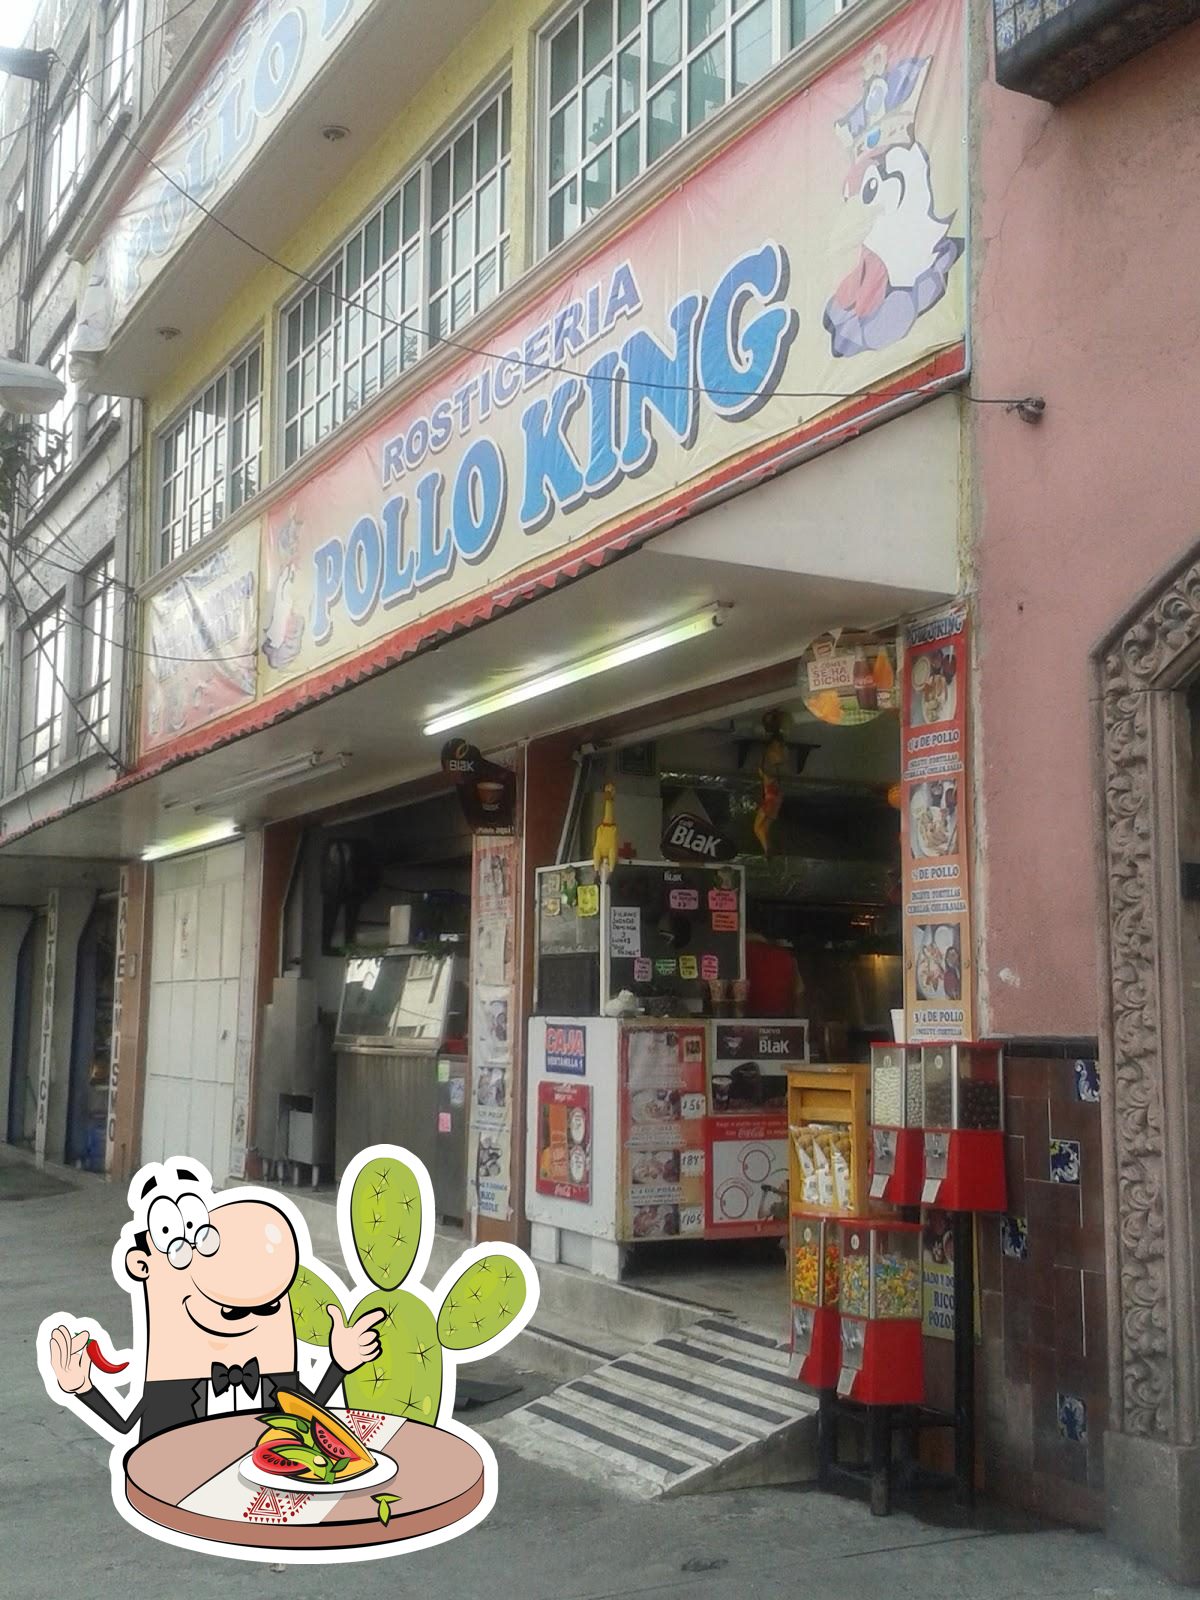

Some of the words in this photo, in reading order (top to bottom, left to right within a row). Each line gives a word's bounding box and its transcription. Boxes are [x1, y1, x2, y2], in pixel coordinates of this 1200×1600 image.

[383, 259, 642, 488] ROSTICERIA
[309, 435, 506, 643] POLLO
[518, 240, 799, 533] KING
[832, 666, 847, 675] HA
[920, 735, 930, 747] DE
[932, 731, 960, 745] POLLO
[919, 868, 929, 879] DE
[931, 866, 959, 878] POLLO
[928, 1011, 938, 1022] DE
[940, 1011, 964, 1022] POLLO
[546, 1028, 584, 1056] CAJA
